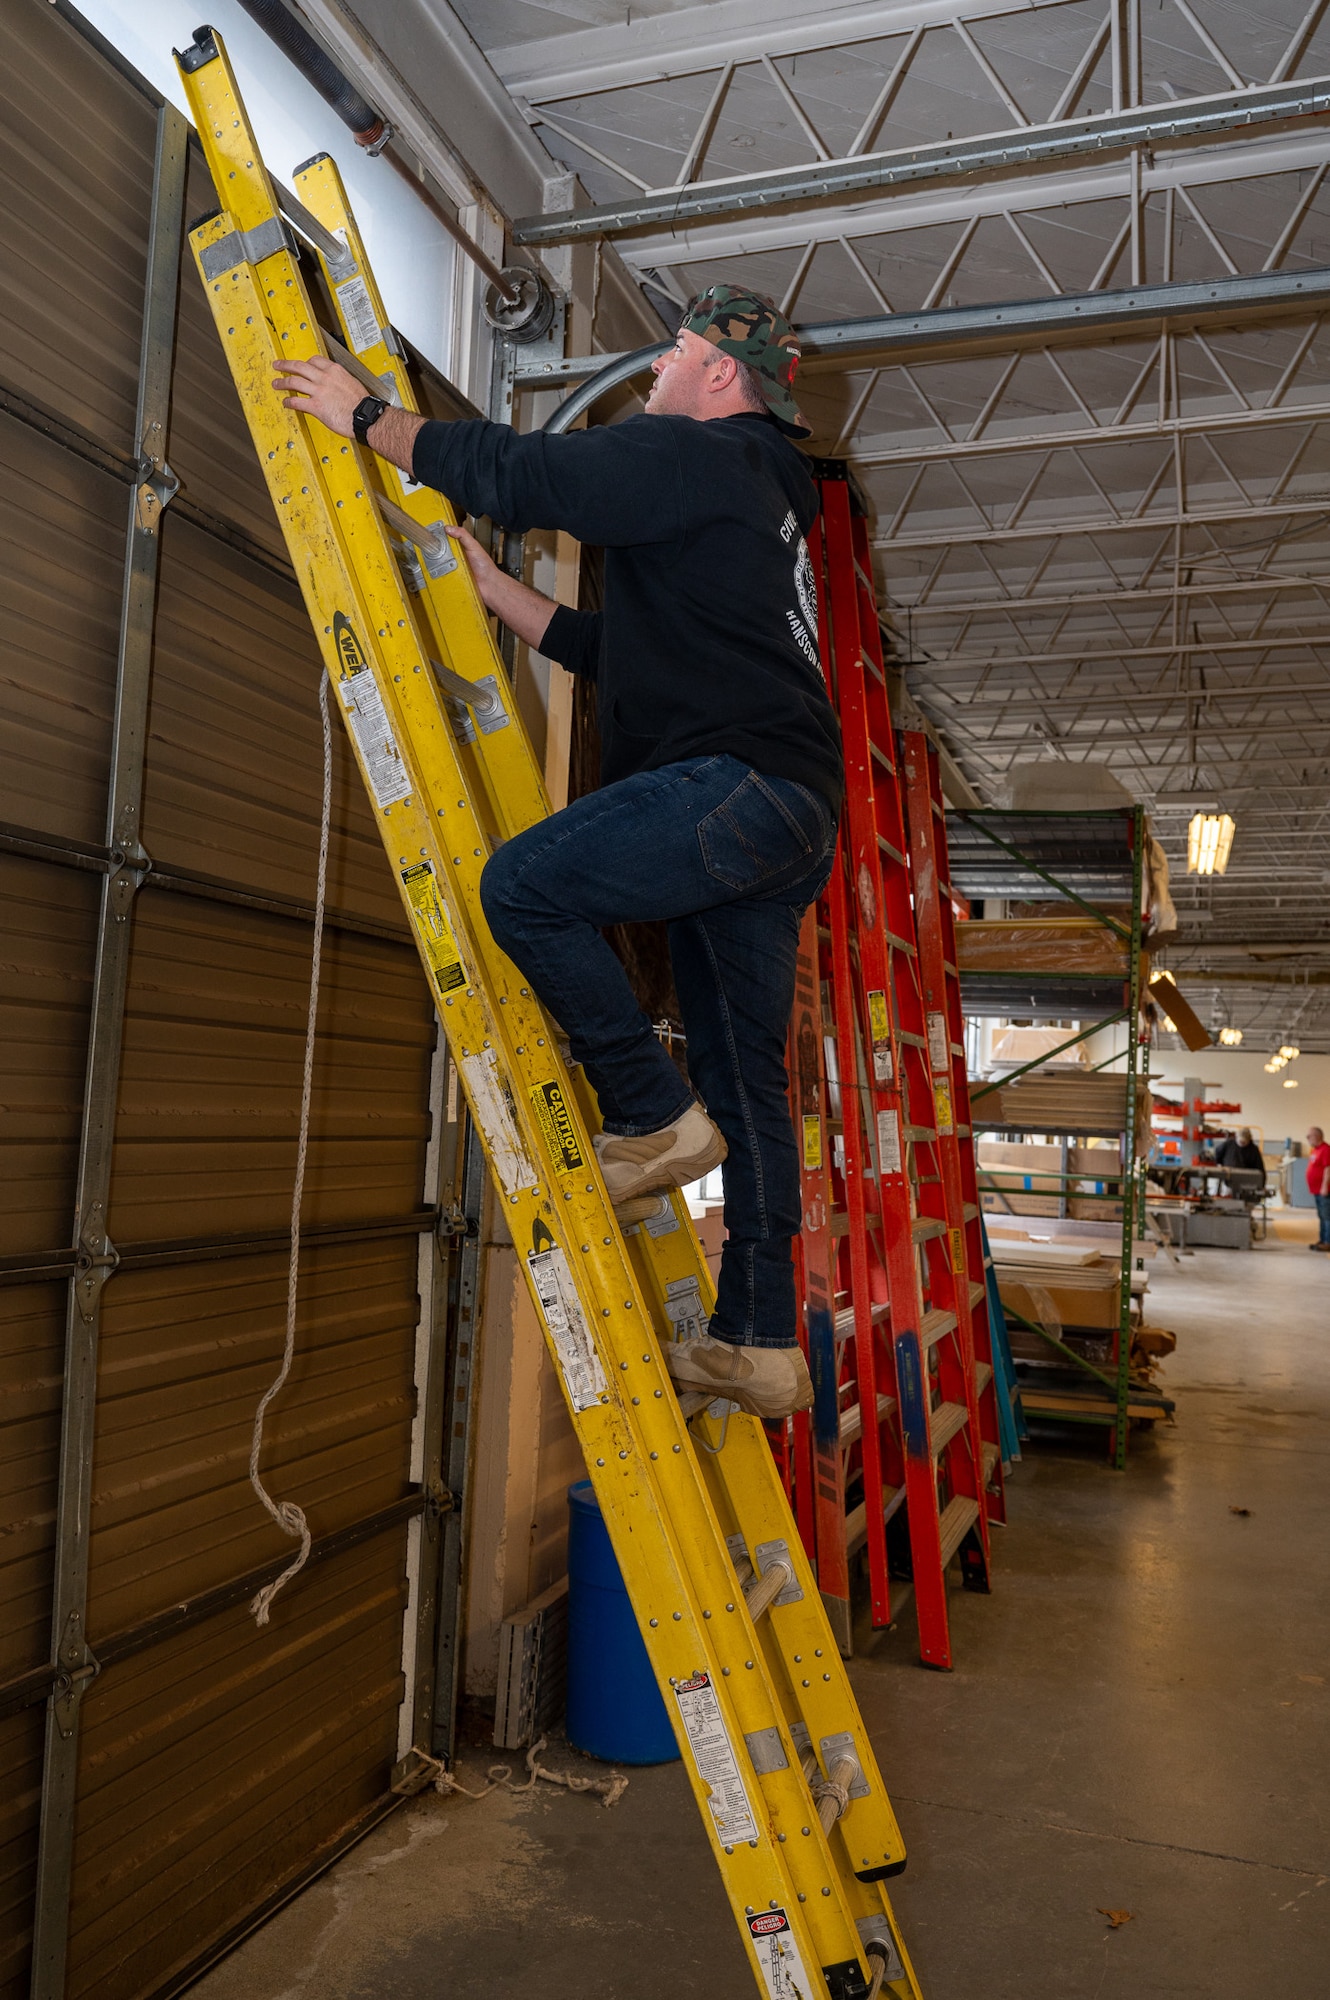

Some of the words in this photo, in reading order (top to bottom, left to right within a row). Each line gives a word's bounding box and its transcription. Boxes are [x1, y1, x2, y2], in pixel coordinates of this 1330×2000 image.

[340, 635, 362, 677] WER
[785, 609, 817, 667] HANSCOM
[549, 1088, 580, 1161] CAUTION
[756, 1916, 779, 1926] DANGER
[757, 1921, 781, 1931] PELIGRO
